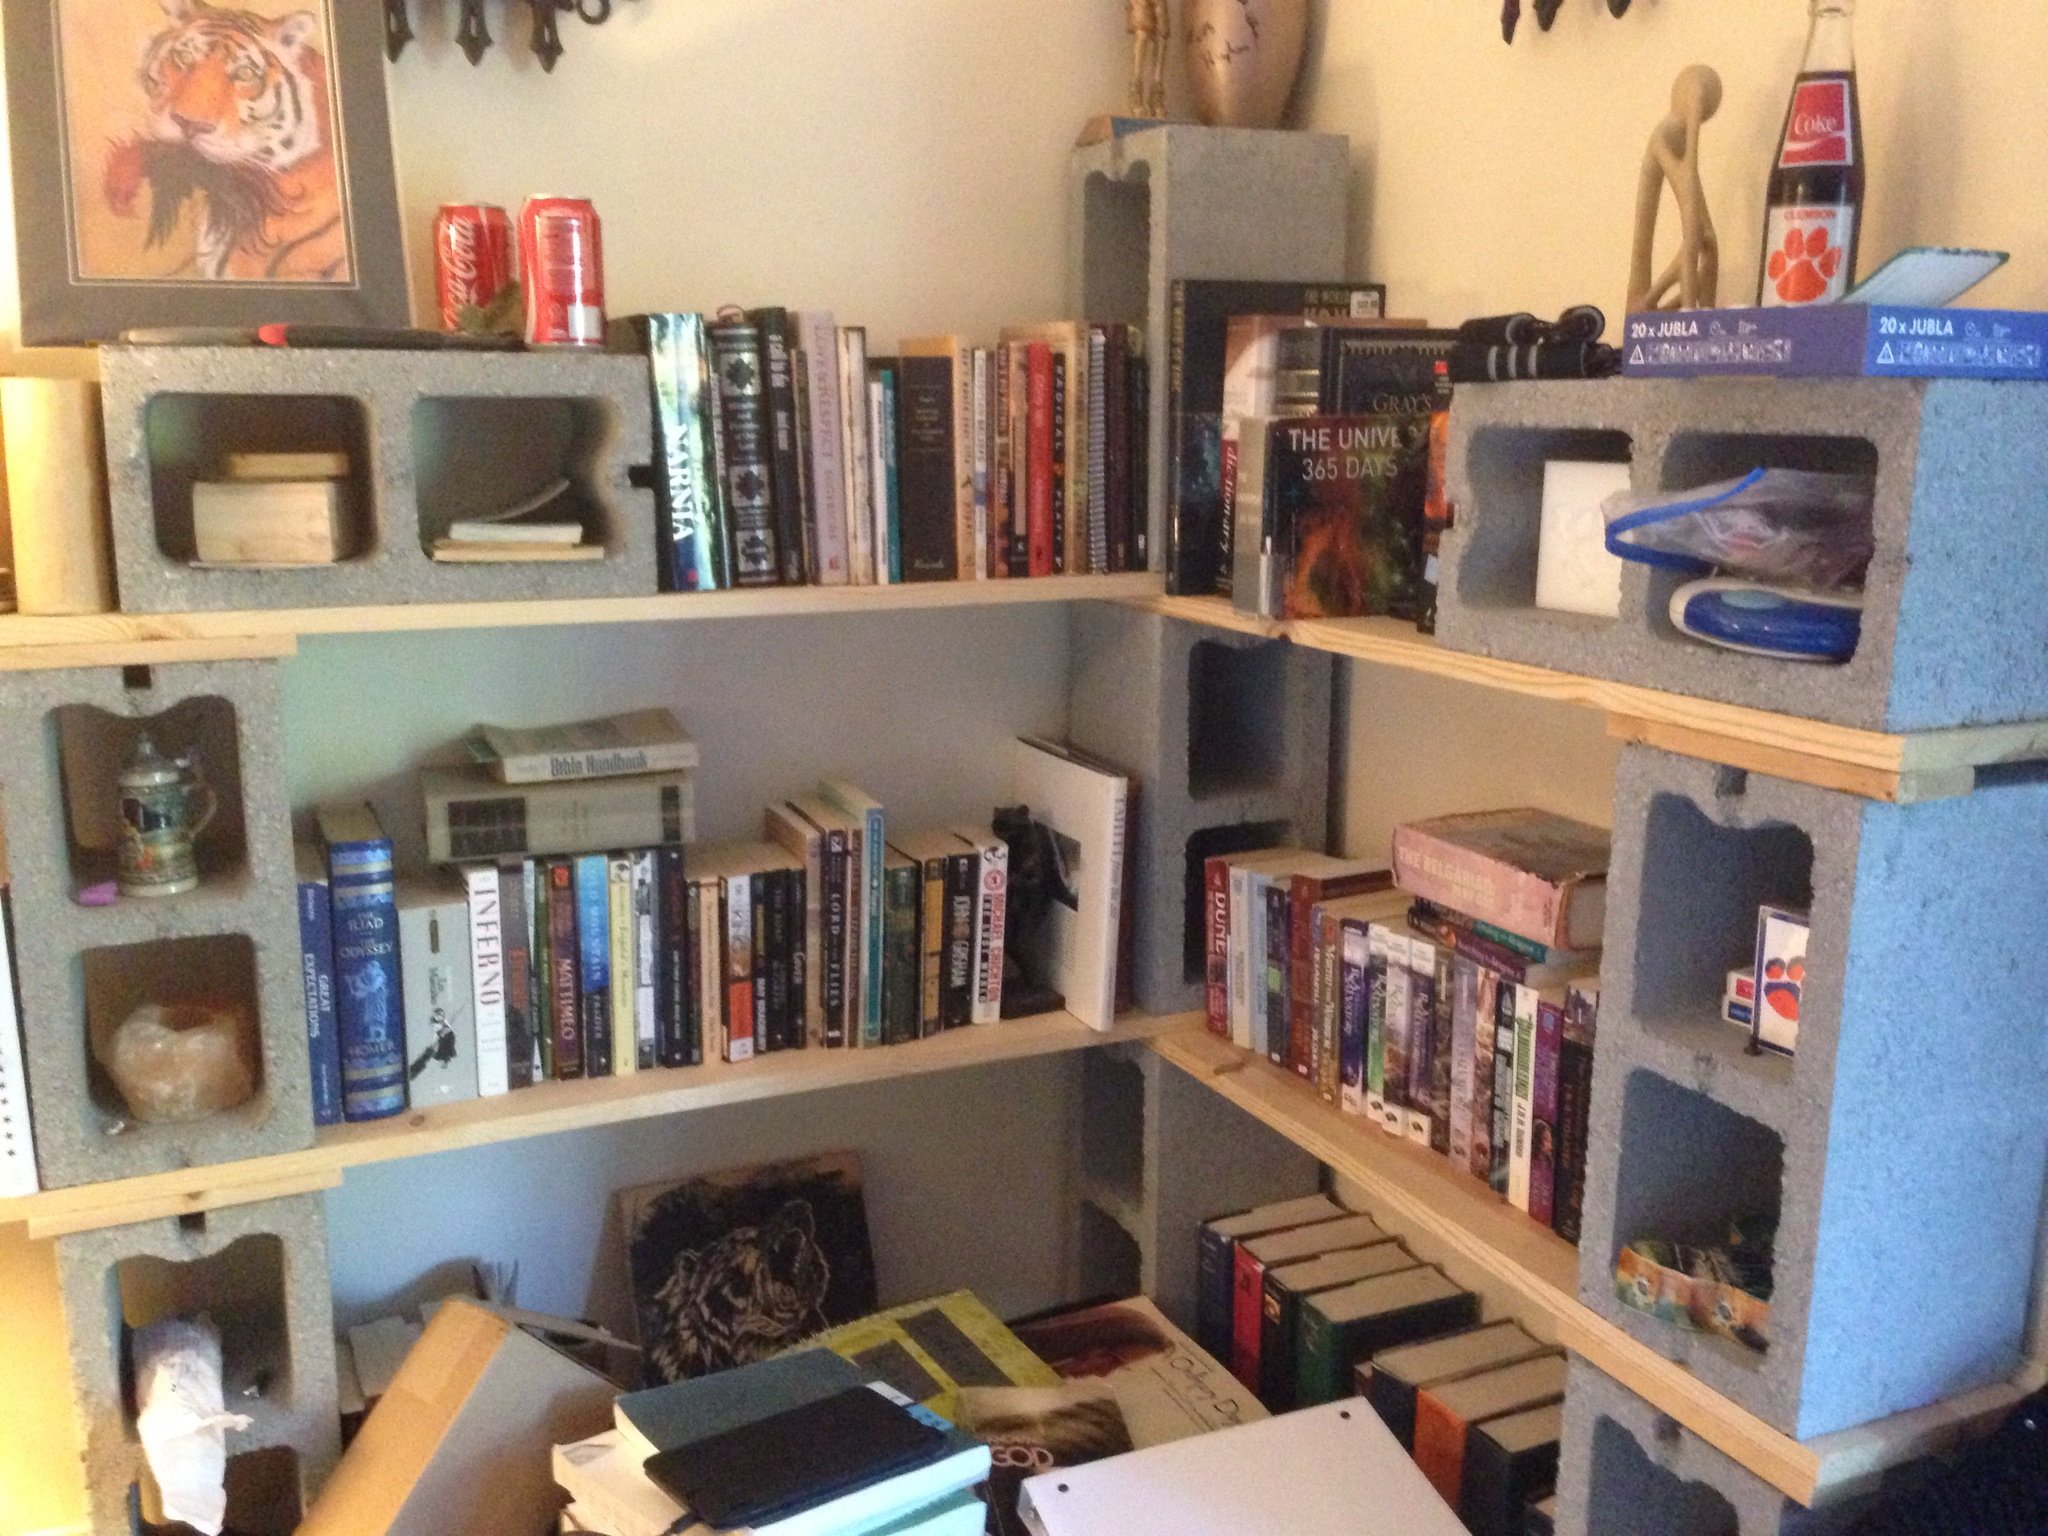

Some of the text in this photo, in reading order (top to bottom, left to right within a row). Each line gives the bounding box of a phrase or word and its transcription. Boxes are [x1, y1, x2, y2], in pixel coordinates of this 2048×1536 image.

[1794, 113, 1838, 135] Coke
[1631, 324, 1646, 338] 20
[1657, 319, 1698, 338] JUBLA
[1880, 316, 1897, 333] 20
[1909, 317, 1953, 335] JUBLA
[1289, 428, 1331, 451] THE
[667, 423, 699, 541] NARNIA
[1302, 457, 1398, 480] 365 DAYS
[550, 757, 583, 777] Bible
[586, 751, 648, 773] Handbook
[348, 918, 384, 932] ILIAD
[830, 893, 841, 935] LORD
[1215, 892, 1226, 954] DUNE
[339, 941, 393, 958] ODYSSEY
[474, 888, 502, 1006] INFERNO
[951, 940, 969, 988] GRISHAM
[304, 953, 321, 1038] EXPECTATIONS
[318, 974, 331, 1012] GREAT
[558, 958, 575, 1040] MATTIMEO
[829, 963, 840, 1007] FLIES
[757, 1000, 766, 1051] BRADBURY
